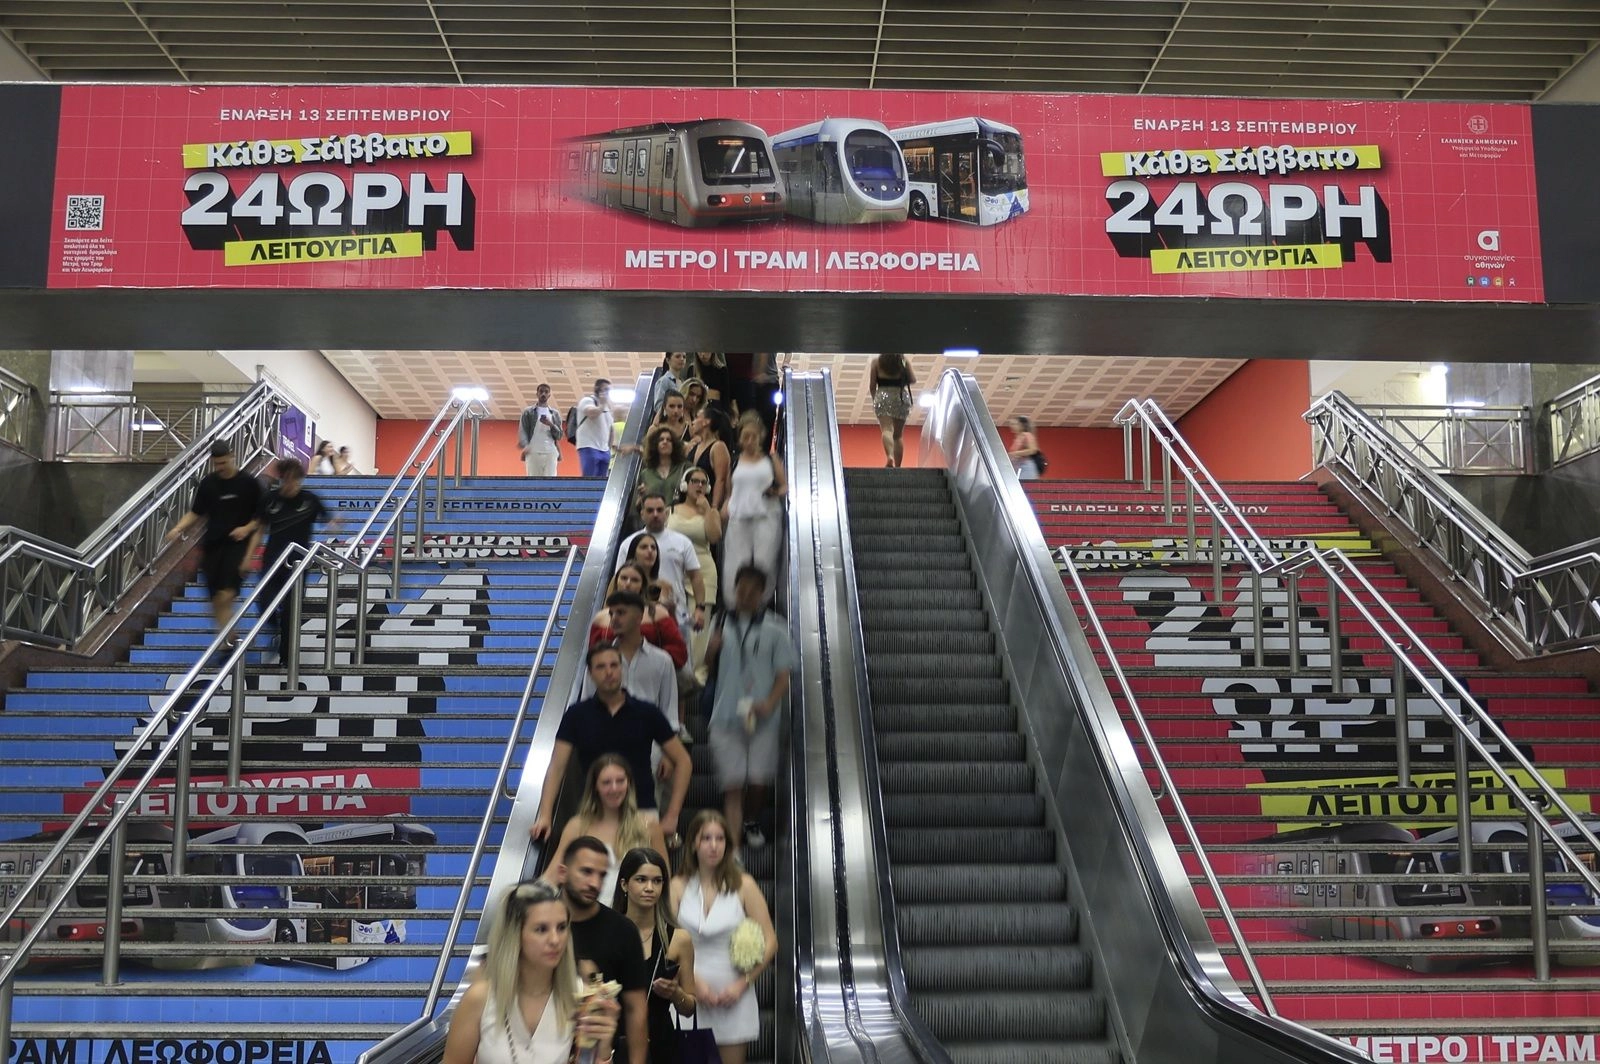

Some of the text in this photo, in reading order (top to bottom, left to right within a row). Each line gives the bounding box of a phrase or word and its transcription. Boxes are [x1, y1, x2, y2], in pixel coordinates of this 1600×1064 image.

[220, 110, 451, 121] ΕΝΑΡΞΗ 13 ΣΕΠΤΕΜΒΡΙΟΥ
[1134, 119, 1357, 135] ΕΝΑΡΞΗ 13 ΣΕΠΤΕΜΒΡΙΟΥ
[206, 132, 448, 168] Κάθε Σάββατο
[1124, 144, 1356, 176] Κάθε Σάββατο
[181, 171, 464, 226] 24ΩΡΗ
[1105, 181, 1378, 238] 24ΩΡΗ
[250, 237, 398, 262] ΛΕΙΤΟΥΡΓΙΑ
[624, 250, 981, 272] ΜΕΤΡΟ ΤΡΑΜ ΛΕΩΦΟΡΕΙΑ
[1176, 247, 1318, 270] ΛΕΙΤΟΥΡΓΙΑ
[1475, 261, 1505, 269] αθηνών
[1118, 571, 1332, 667] 24
[1201, 678, 1500, 752] ΩΡΗ
[10, 1040, 332, 1064] ΑΜ ΛΕΩΦΟΡΕΙΑ
[1492, 1034, 1596, 1063] ΤΡΑΜ
